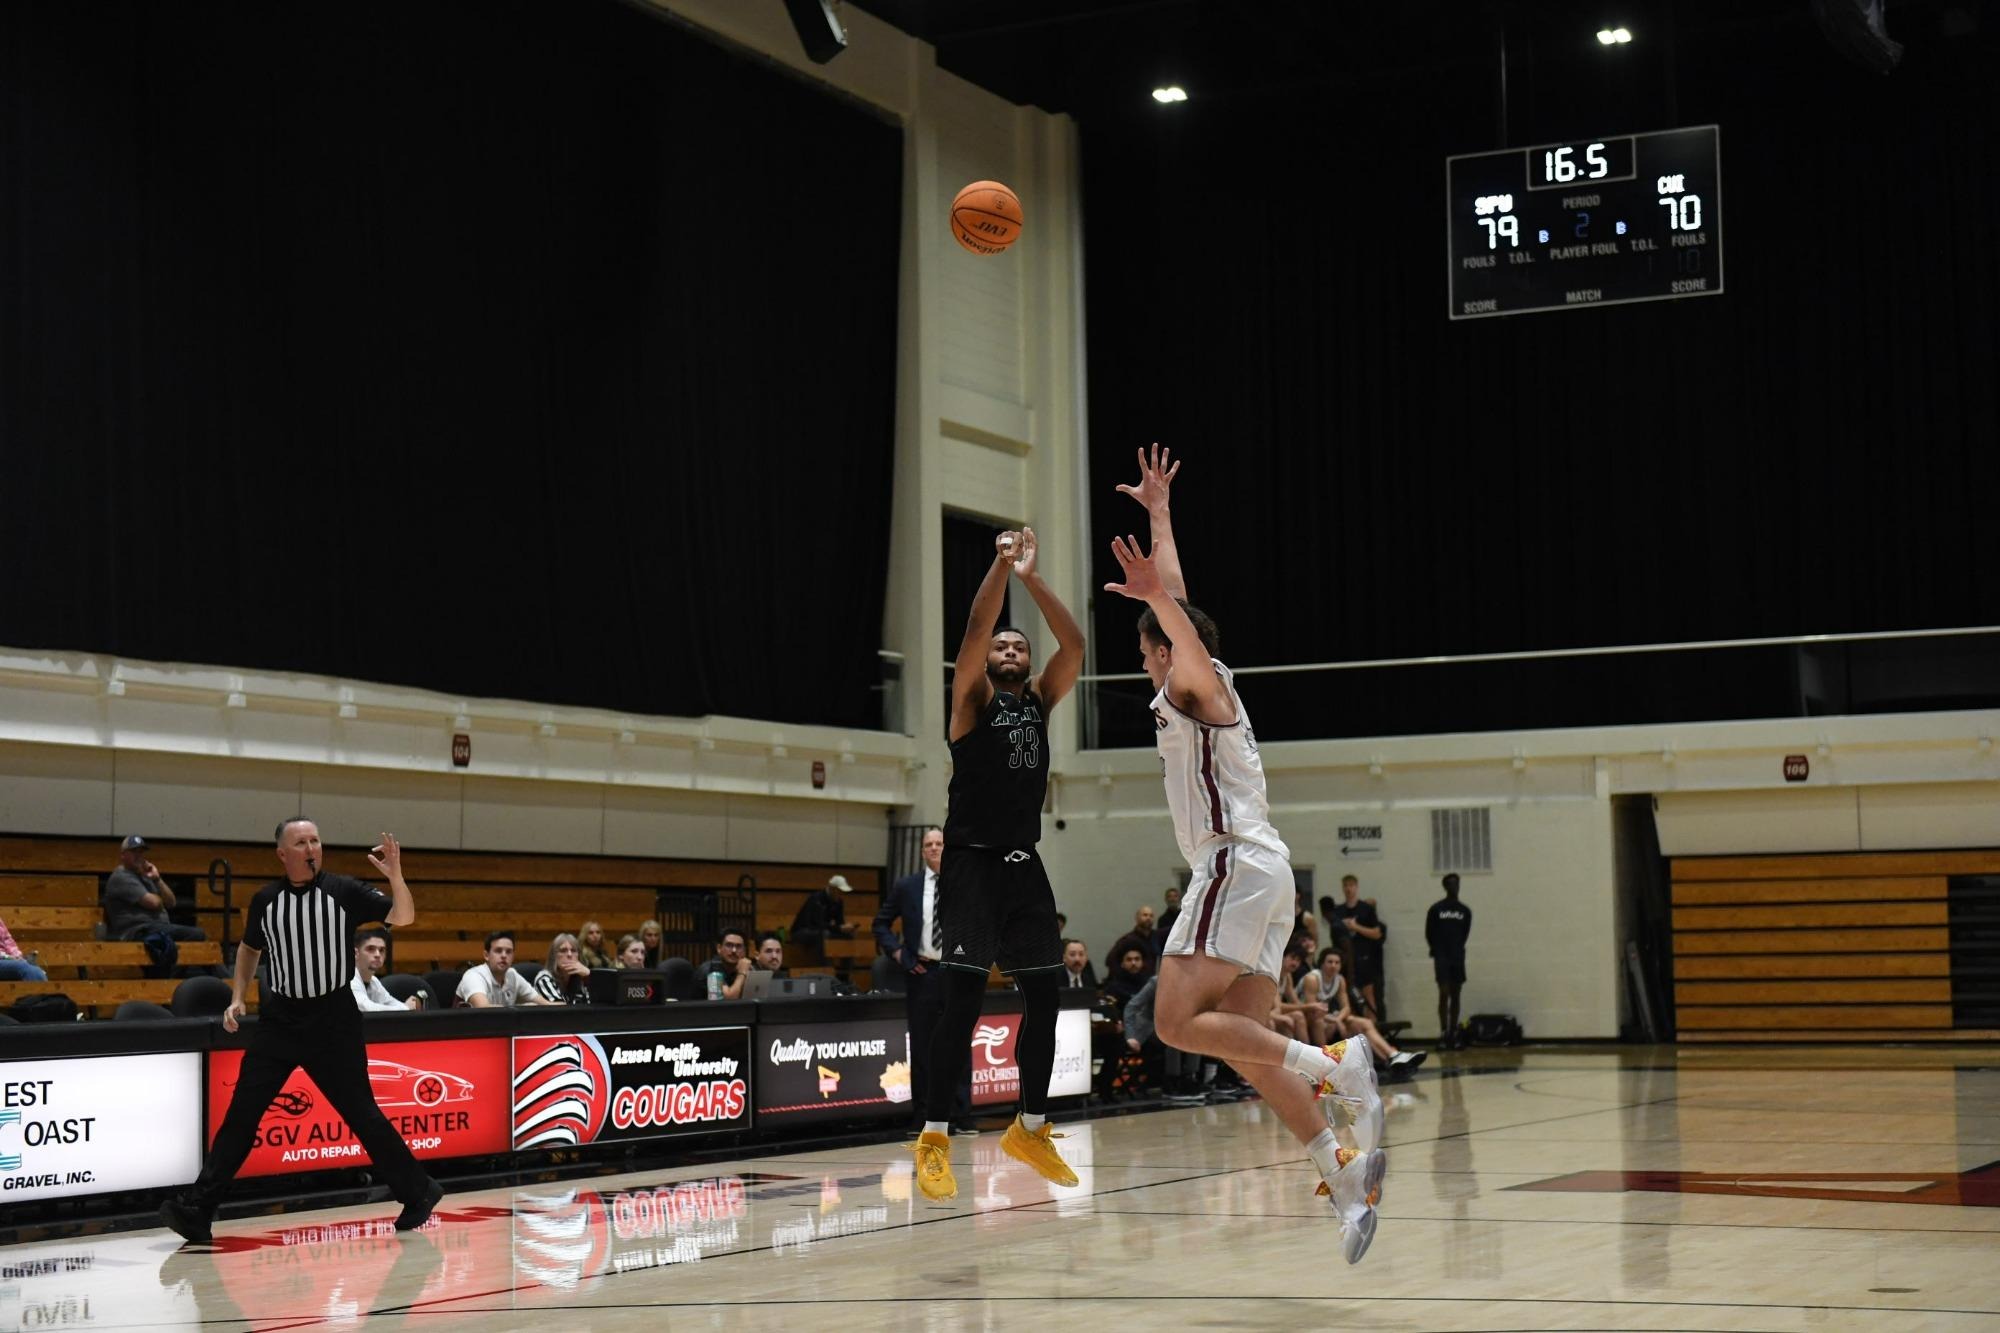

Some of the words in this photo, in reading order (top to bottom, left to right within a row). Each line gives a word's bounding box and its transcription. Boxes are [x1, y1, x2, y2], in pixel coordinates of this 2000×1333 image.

[1545, 143, 1608, 182] 16.5
[1562, 195, 1601, 210] PERIOD
[1658, 195, 1701, 231] 70
[1478, 215, 1519, 249] 79
[1575, 213, 1589, 238] 2
[1550, 244, 1589, 261] PLAYER
[1591, 242, 1619, 257] FOUL
[1671, 233, 1706, 248] FOULS
[1463, 254, 1497, 269] FOULS
[1566, 289, 1602, 305] MATCH
[1671, 278, 1707, 294] SCORE
[1464, 300, 1498, 315] SCORE
[1008, 726, 1040, 769] 33
[1337, 825, 1383, 840] RESTROOMS
[611, 1046, 652, 1065] Azusa
[654, 1042, 701, 1062] Pacific
[770, 1037, 815, 1070] Quality
[815, 1042, 837, 1060] YOU
[838, 1040, 860, 1057] CAN
[860, 1039, 887, 1056] TASTE
[673, 1056, 739, 1078] University
[611, 1078, 746, 1130] COUGARS
[252, 1124, 300, 1148] SGV
[281, 1147, 318, 1163] AUTO
[320, 1144, 361, 1159] REPAIR
[411, 1137, 442, 1150] SHOP
[65, 1170, 96, 1185] INC.
